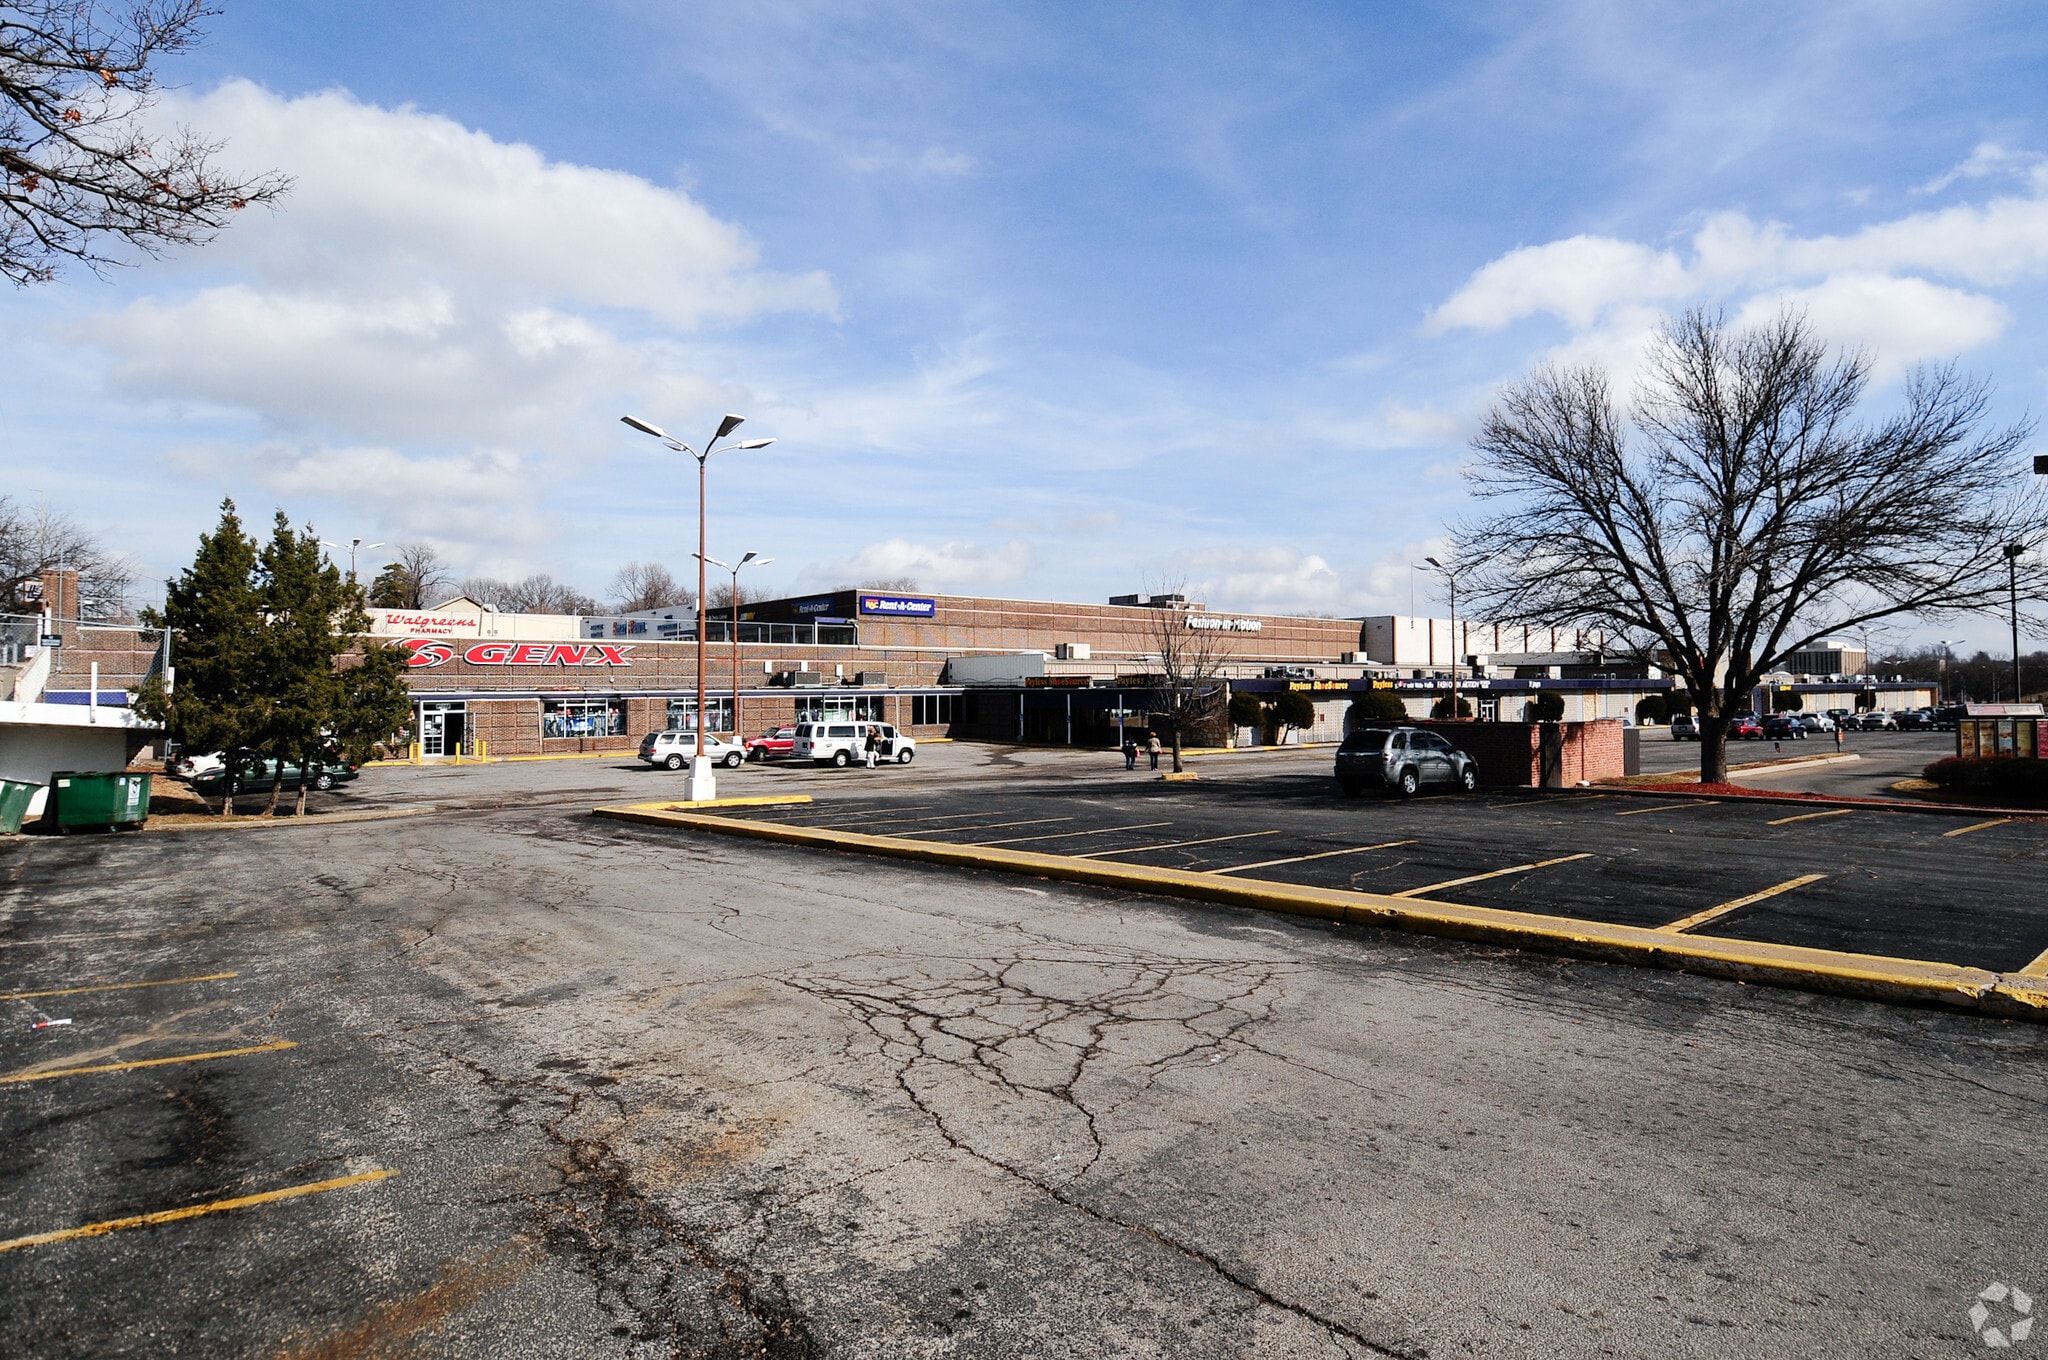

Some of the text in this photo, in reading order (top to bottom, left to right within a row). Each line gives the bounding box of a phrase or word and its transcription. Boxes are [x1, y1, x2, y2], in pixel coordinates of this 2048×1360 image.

[387, 614, 477, 627] Walgreens
[1026, 676, 1089, 687] Payless ShoeSource
[1118, 676, 1144, 686] Payless
[1289, 681, 1349, 691] Payless ShoeSource
[1373, 680, 1394, 690] Payless
